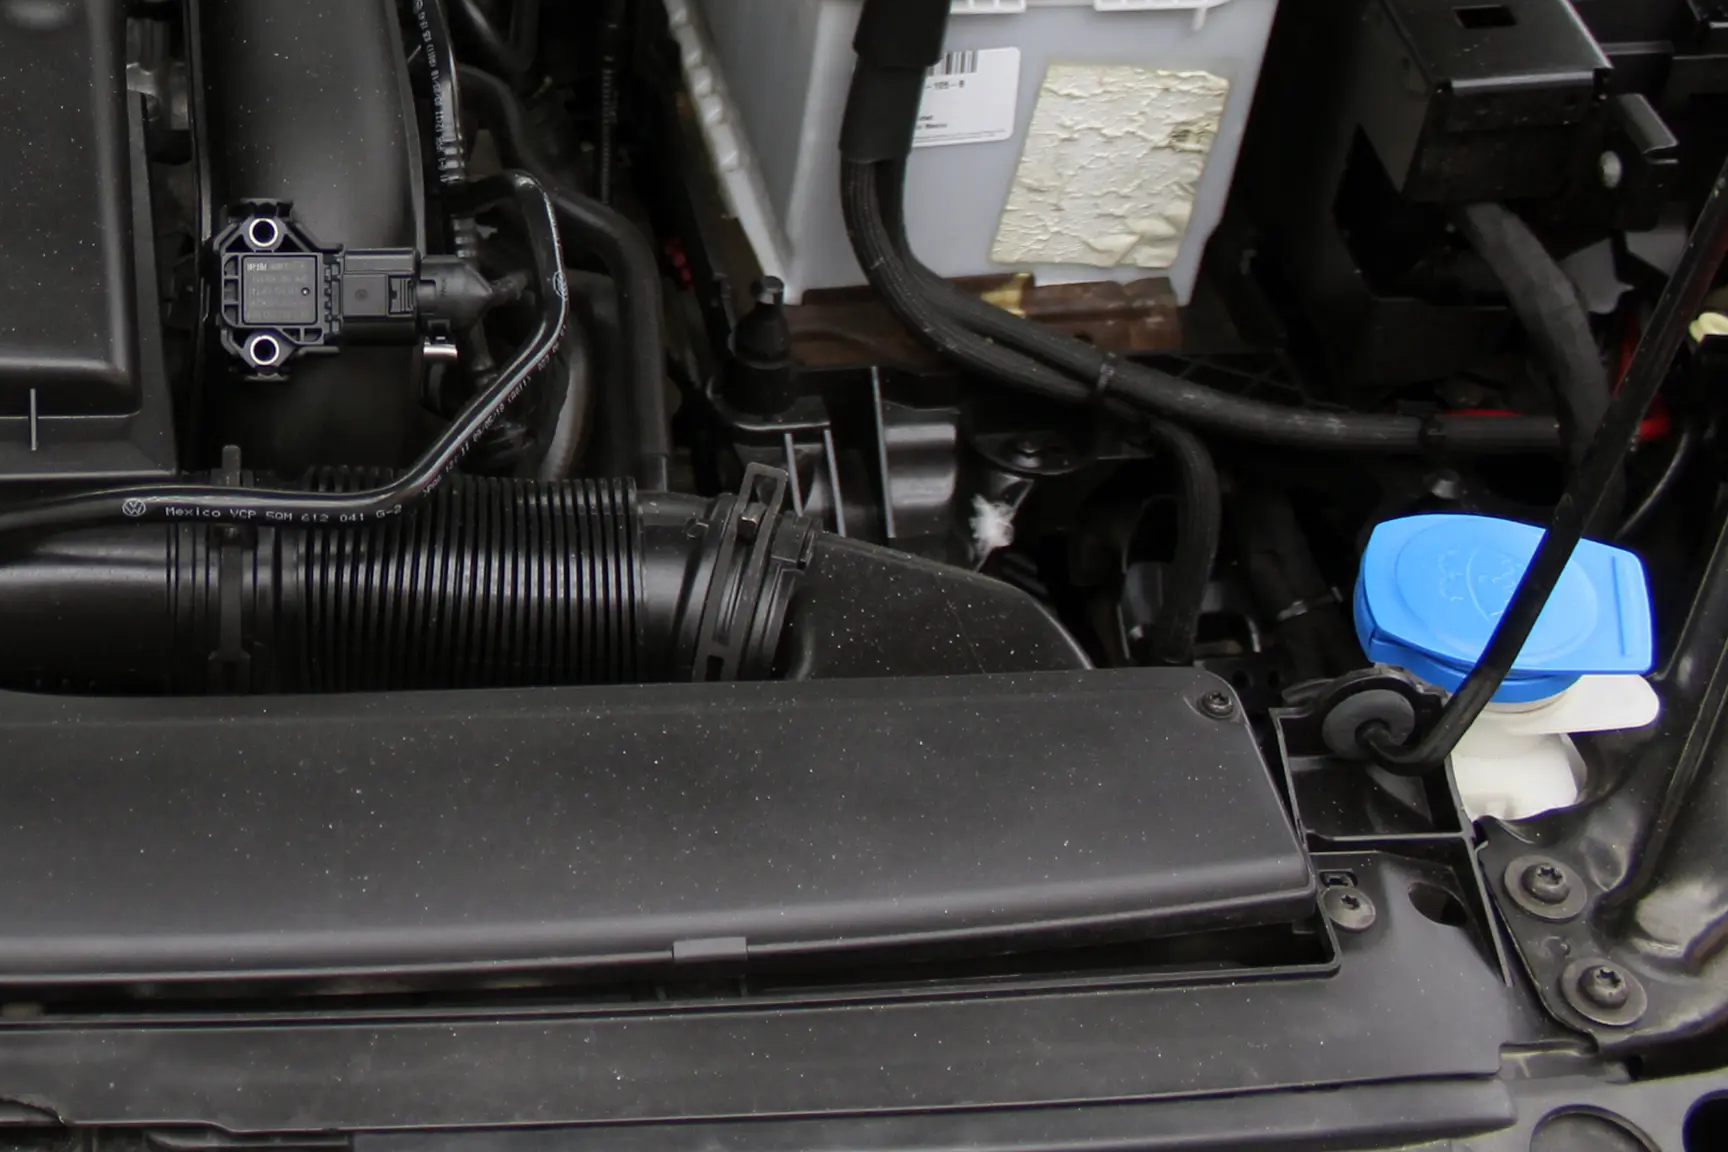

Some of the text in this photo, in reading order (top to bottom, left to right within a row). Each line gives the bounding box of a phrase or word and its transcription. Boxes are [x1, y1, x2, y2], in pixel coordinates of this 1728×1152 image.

[165, 506, 221, 519] Mexico
[230, 508, 257, 520] VCP
[301, 512, 329, 523] 612
[339, 512, 365, 523] 041
